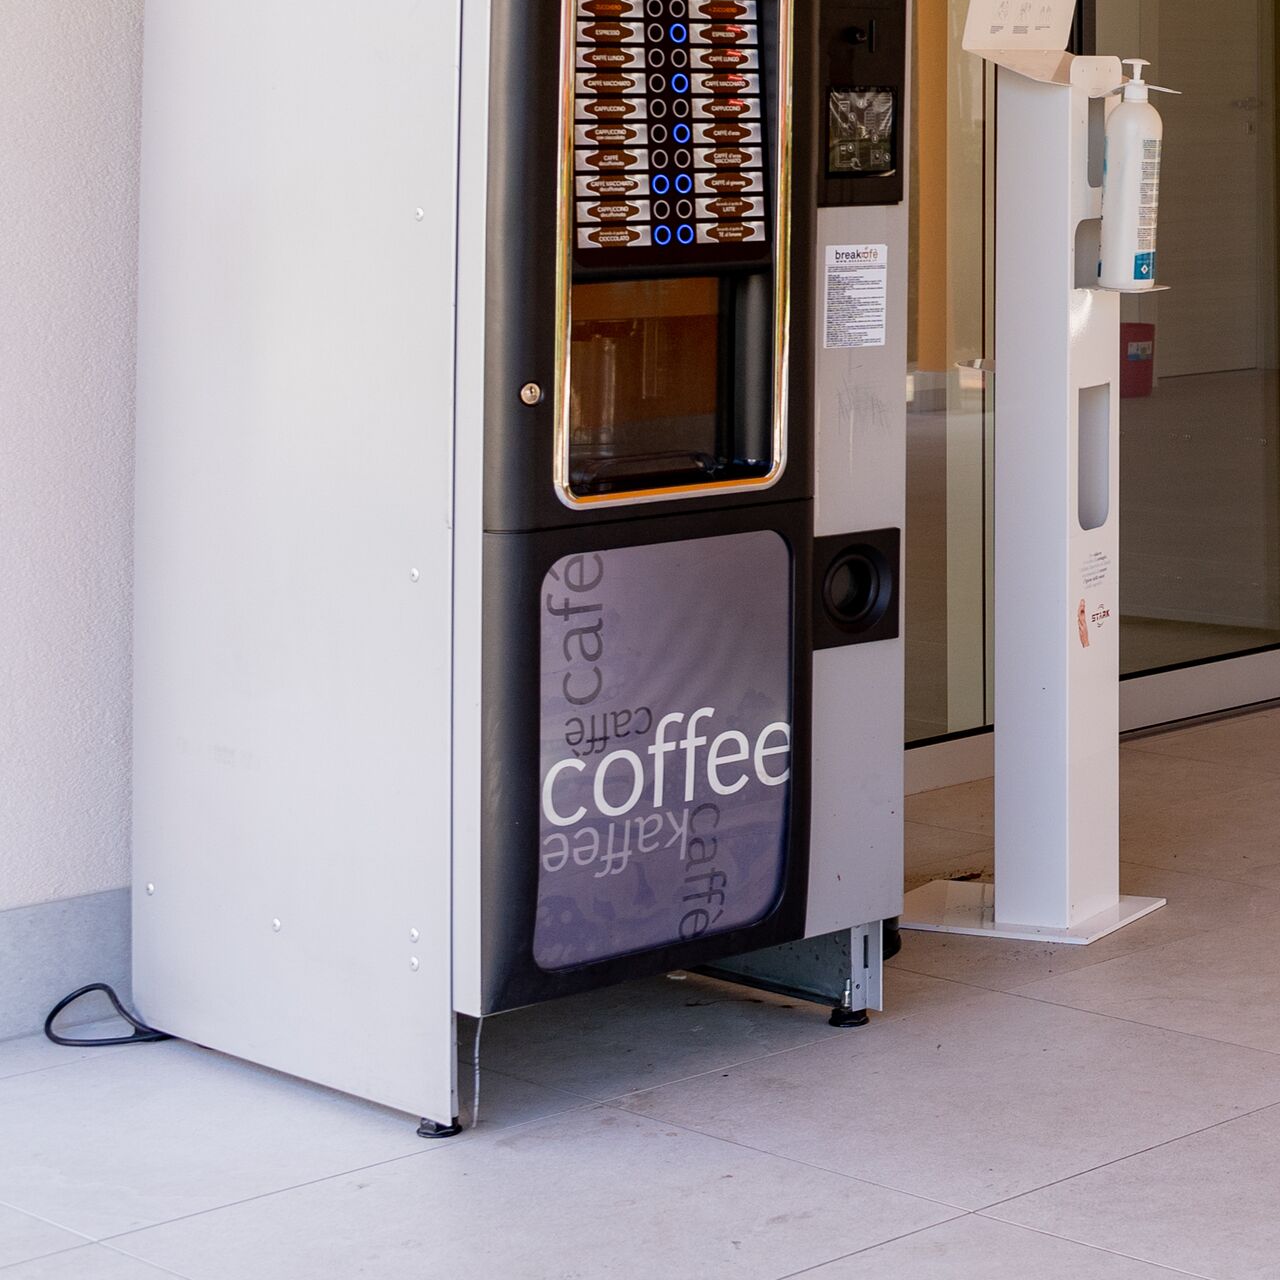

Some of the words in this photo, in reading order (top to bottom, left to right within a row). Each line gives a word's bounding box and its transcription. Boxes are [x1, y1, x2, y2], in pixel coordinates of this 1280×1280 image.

[547, 554, 604, 705] café
[542, 707, 790, 826] coffee
[565, 706, 653, 757] caffè
[542, 808, 689, 878] kaffee
[678, 803, 727, 939] caffè
